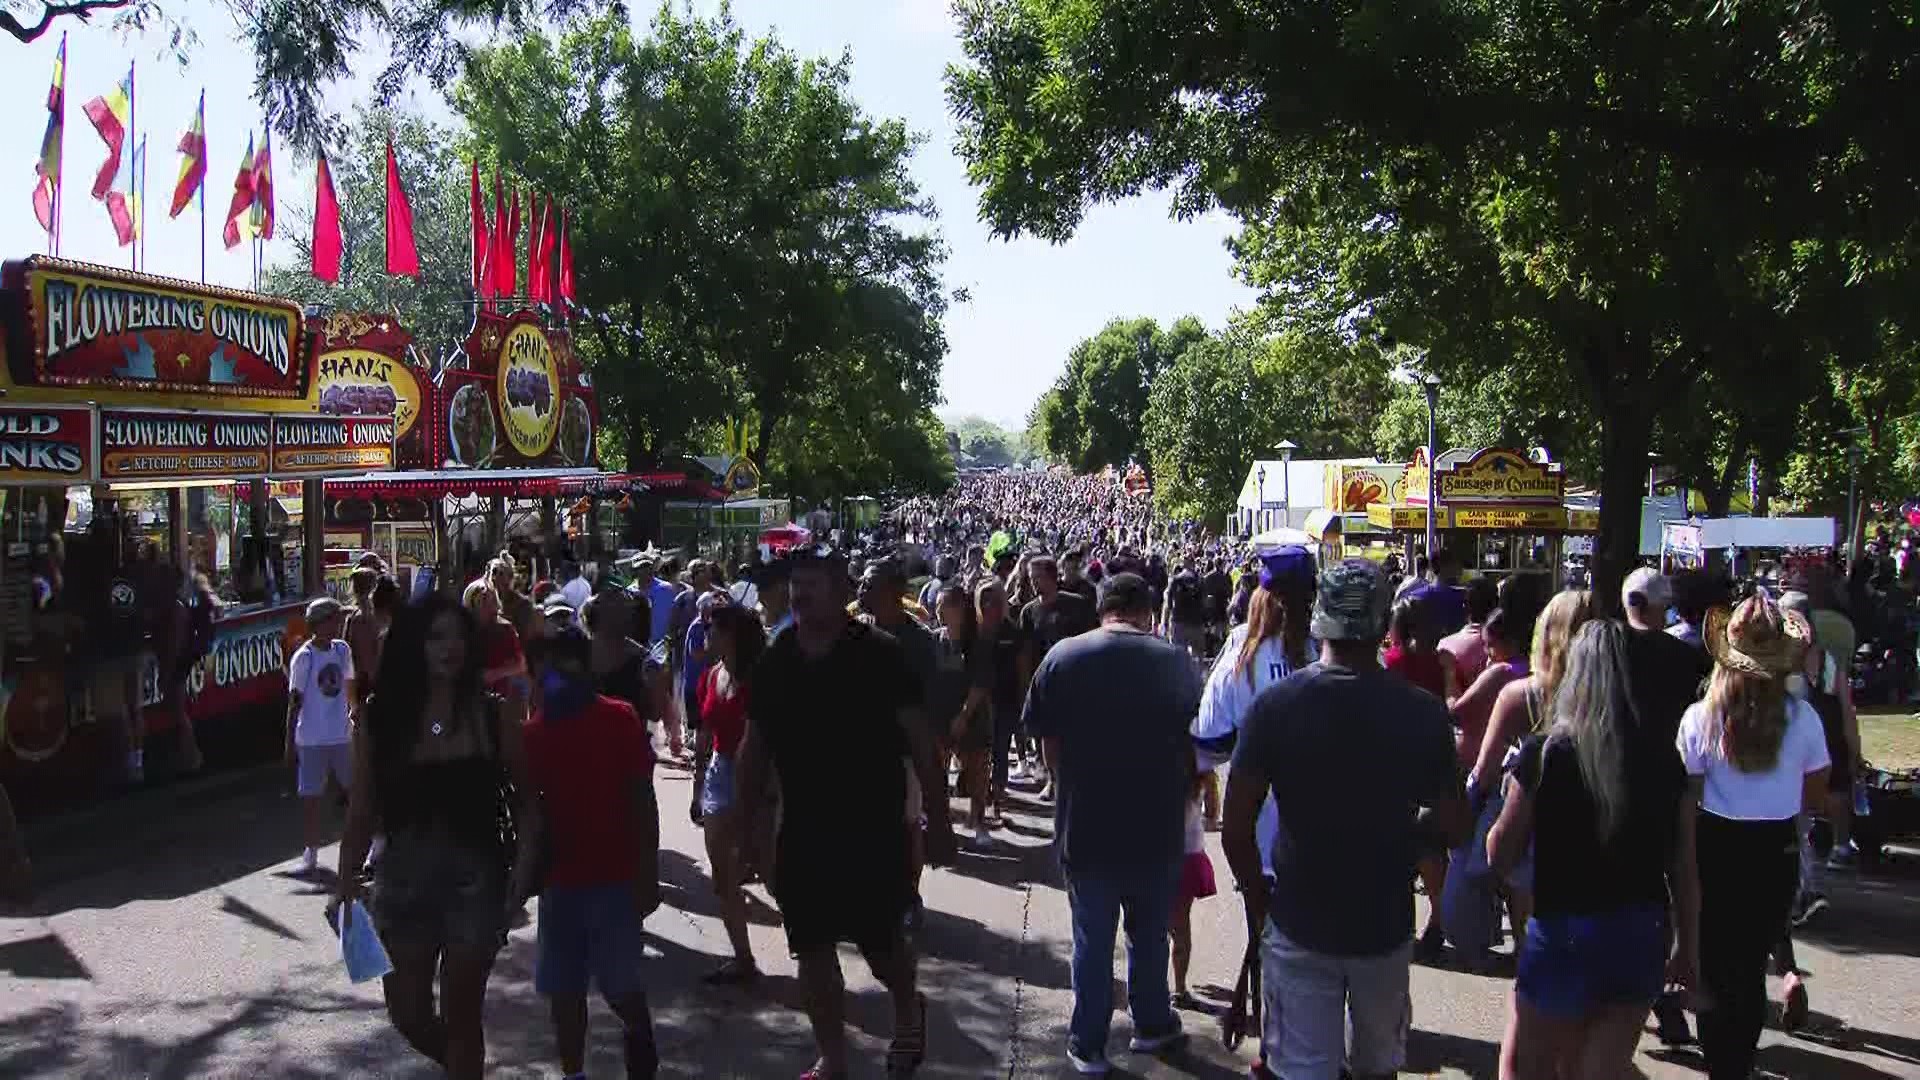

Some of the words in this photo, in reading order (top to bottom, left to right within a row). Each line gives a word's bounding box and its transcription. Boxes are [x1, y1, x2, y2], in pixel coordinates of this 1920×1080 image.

[46, 281, 205, 357] FLOWERING
[211, 304, 289, 375] ONIONS
[319, 356, 392, 382] HAN'S
[105, 419, 208, 446] FLOWERING
[214, 422, 268, 446] ONIONS
[276, 423, 348, 445] FLOWERING
[352, 423, 392, 443] ONIONS
[134, 456, 181, 470] KETCHUP
[188, 455, 224, 469] CHEESE
[231, 455, 258, 468] RANCH
[215, 633, 283, 687] ONIONS
